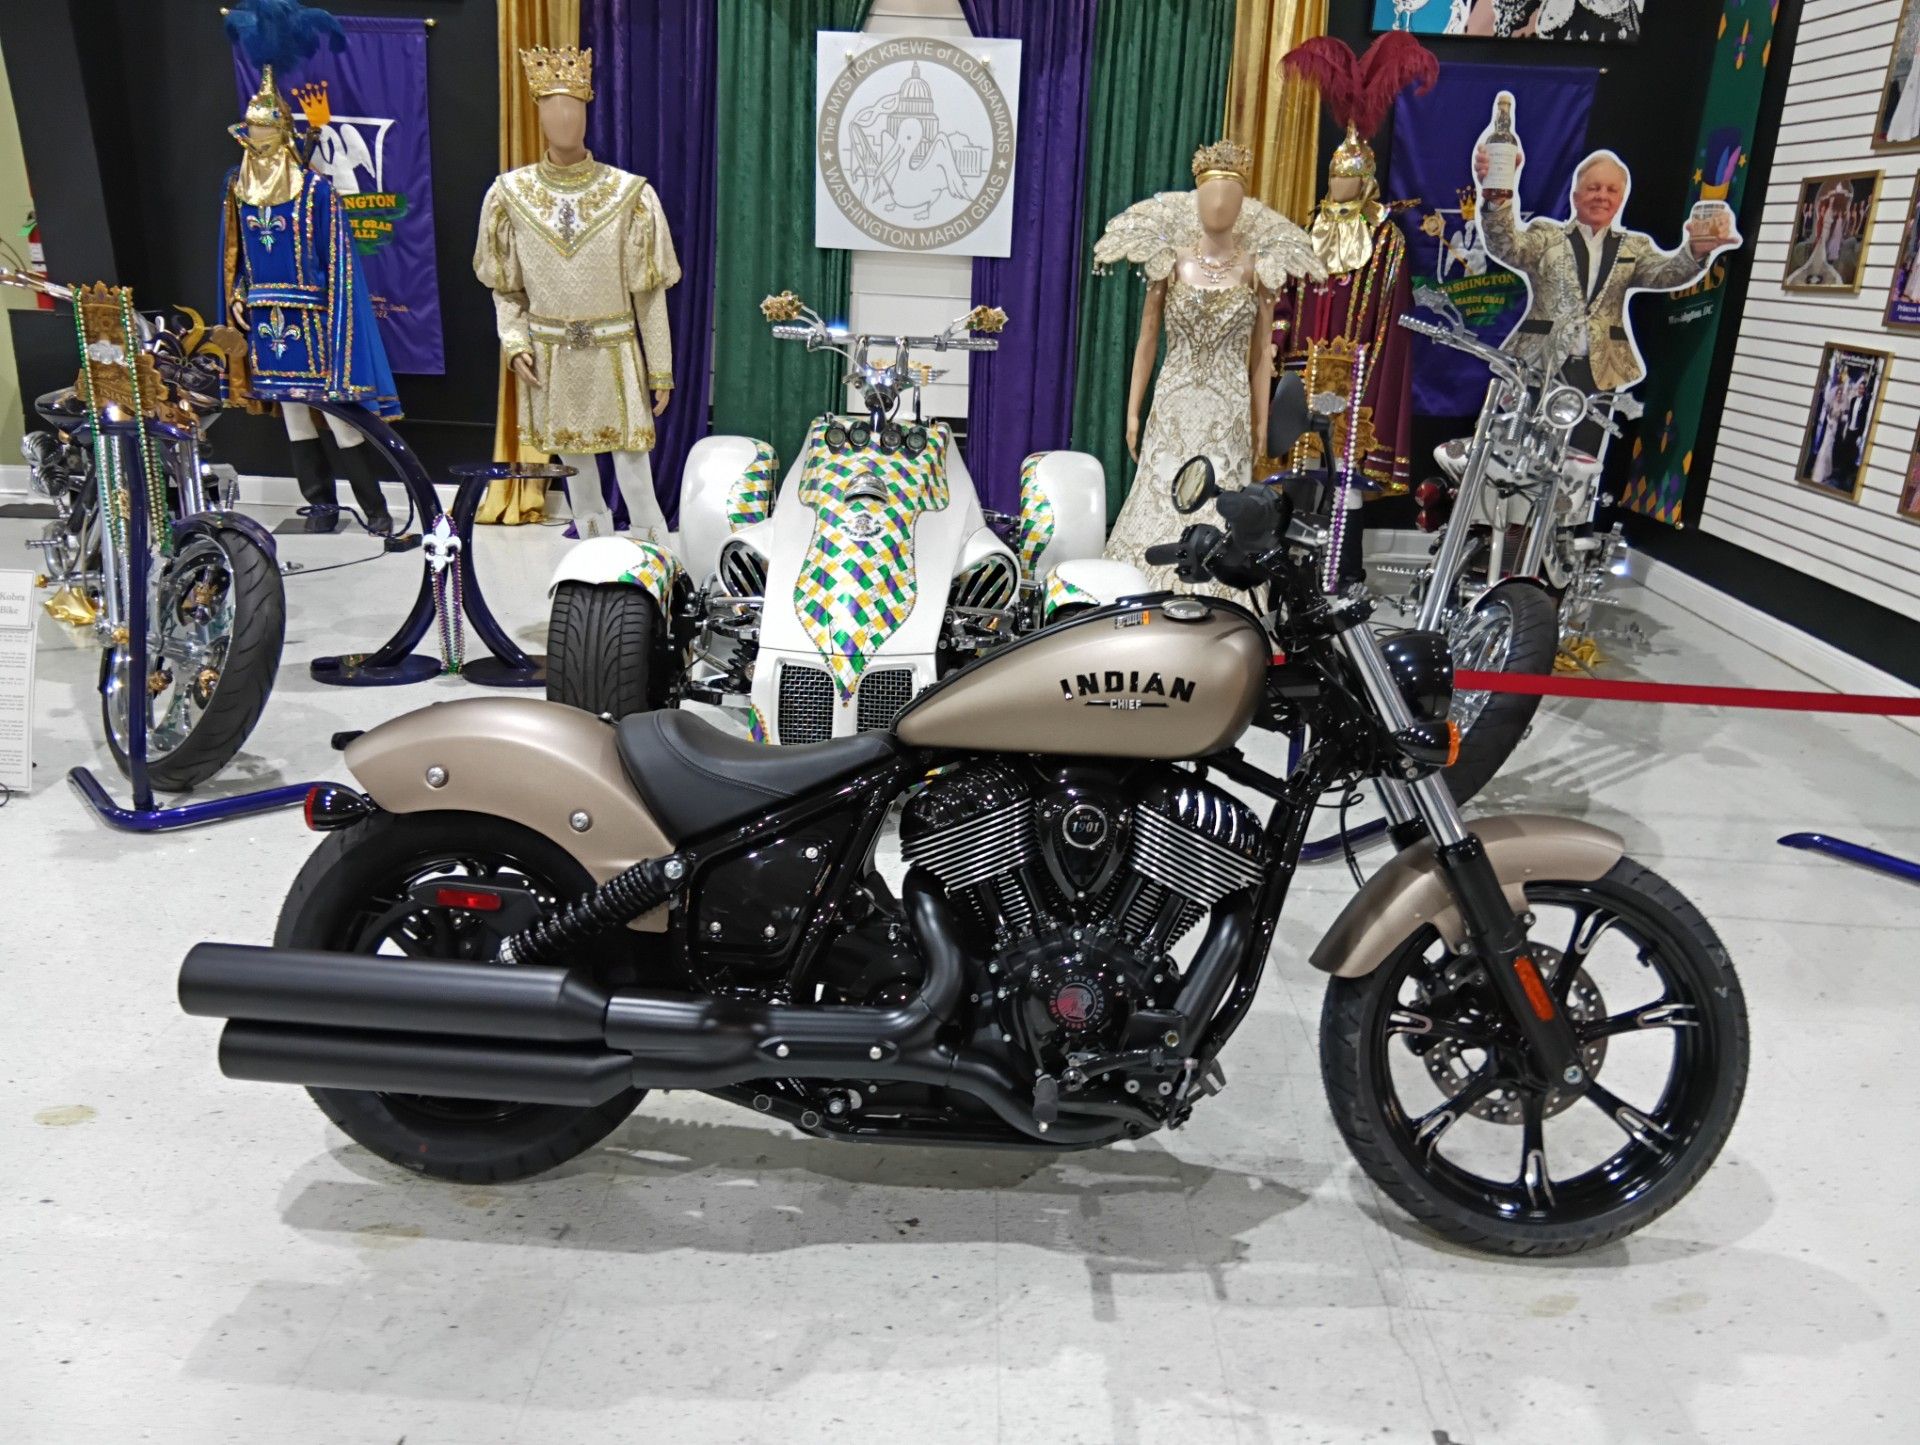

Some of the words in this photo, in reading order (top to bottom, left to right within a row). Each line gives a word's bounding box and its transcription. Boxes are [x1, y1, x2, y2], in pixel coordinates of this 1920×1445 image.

[880, 41, 934, 61] KREWE
[937, 46, 953, 59] of
[828, 55, 878, 114] MYSTICK
[953, 52, 1010, 154] LOUISIANIANS
[822, 117, 836, 144] The
[343, 194, 396, 209] NGTON
[825, 166, 915, 247] WASHINGTON
[919, 216, 973, 248] MARDI
[971, 174, 1005, 220] GRAS
[353, 229, 378, 239] ALL
[1060, 671, 1196, 702] INDIAN
[1110, 698, 1142, 710] CHIEF
[1072, 821, 1100, 832] 1901
